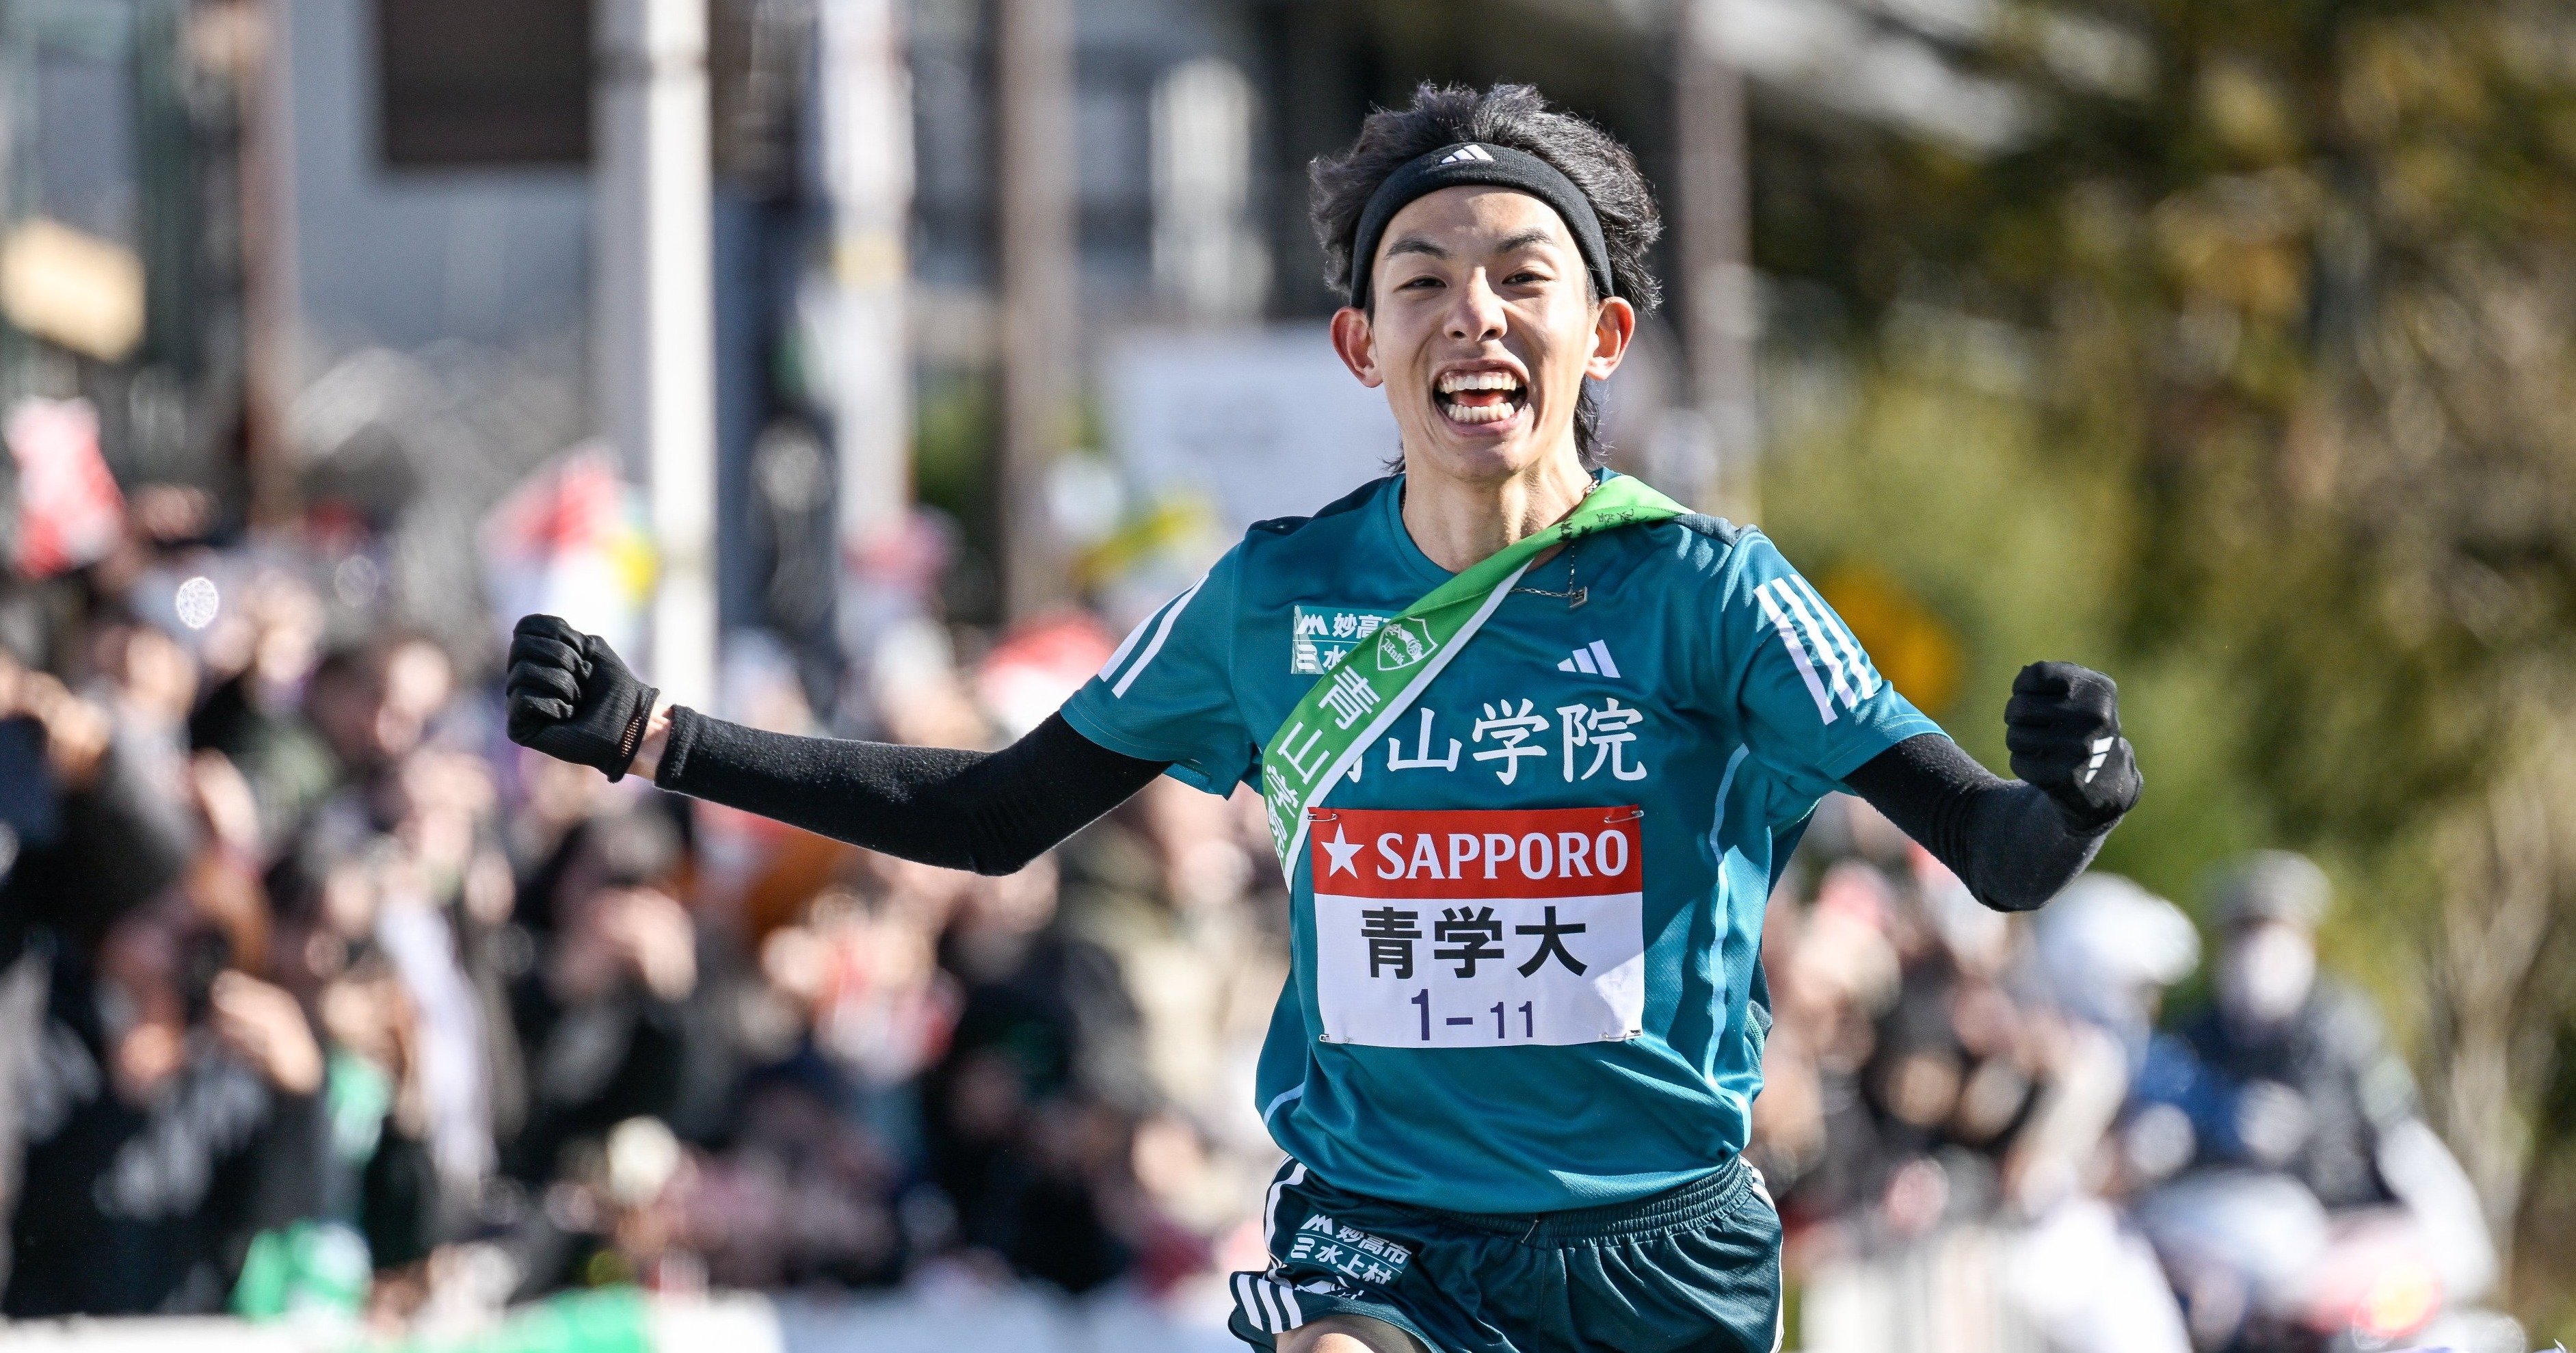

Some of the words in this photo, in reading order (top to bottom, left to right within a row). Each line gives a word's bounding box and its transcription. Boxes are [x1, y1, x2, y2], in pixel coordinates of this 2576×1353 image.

[1332, 612, 1392, 639] 妙高
[1347, 698, 1647, 785] 山学院
[1376, 829, 1629, 880] SAPPORO
[1361, 906, 1588, 980] 青学大
[1315, 1244, 1393, 1285] 水上村
[1336, 1225, 1413, 1264] 妙高市
